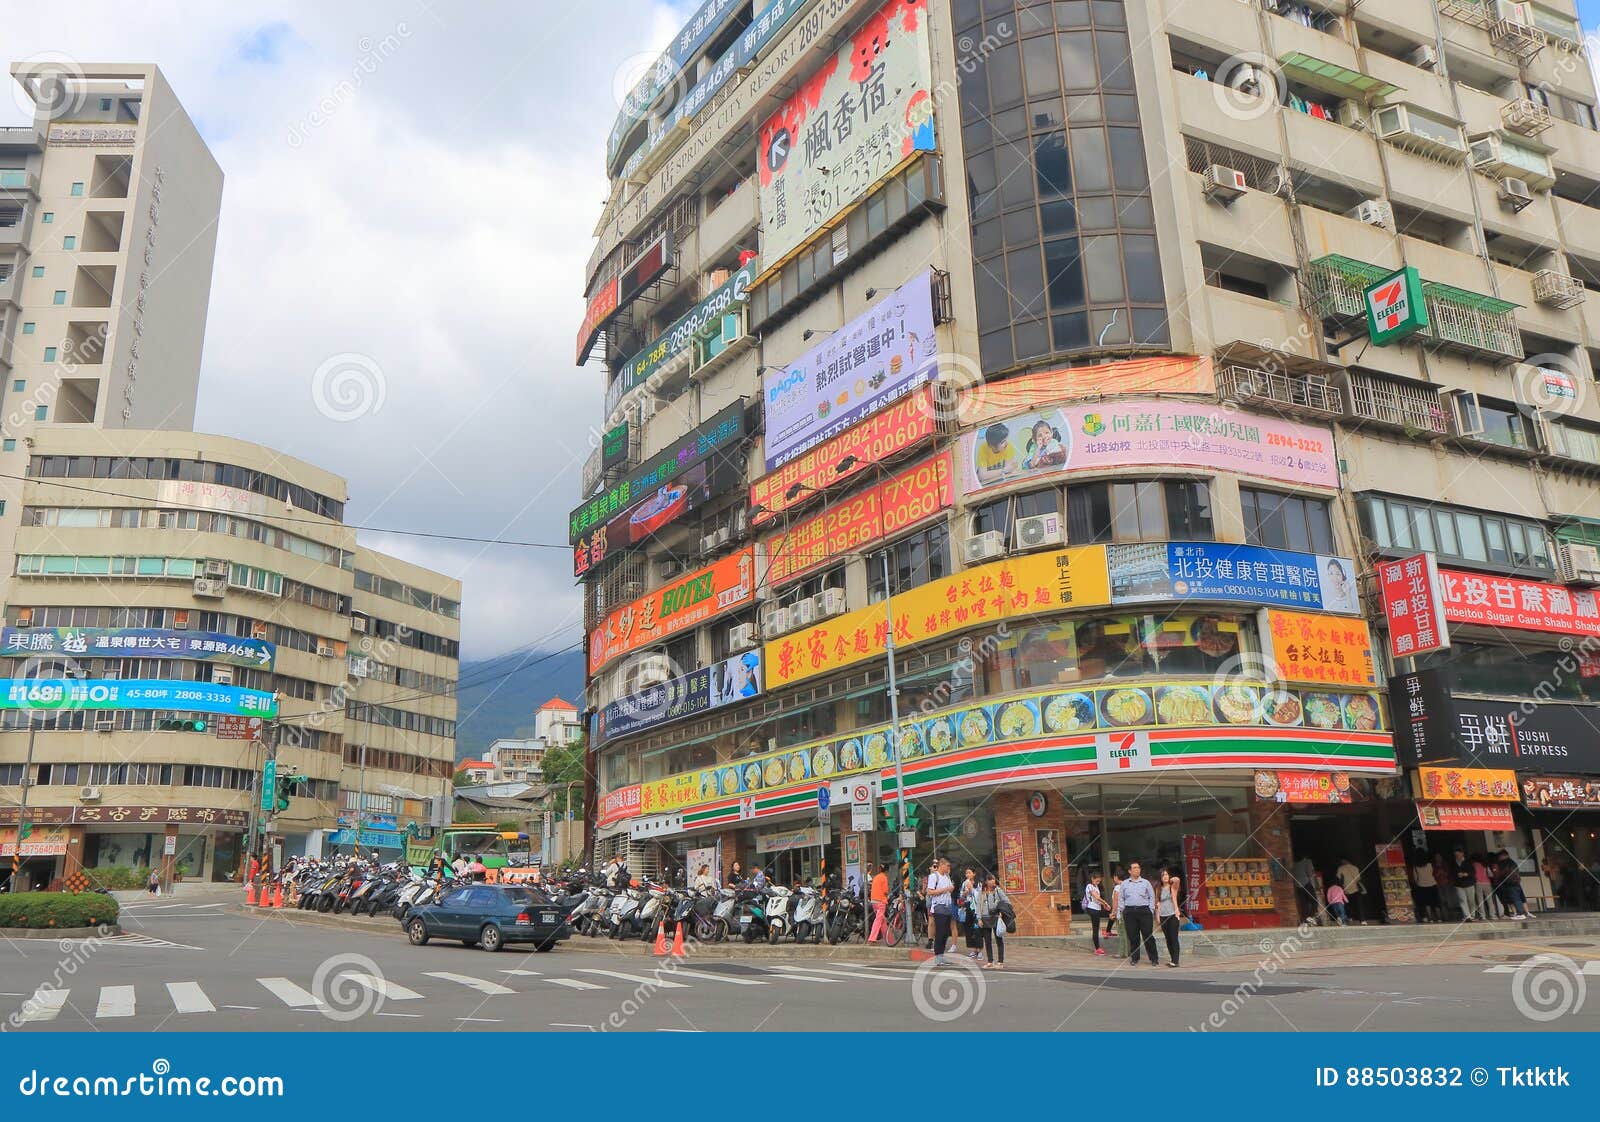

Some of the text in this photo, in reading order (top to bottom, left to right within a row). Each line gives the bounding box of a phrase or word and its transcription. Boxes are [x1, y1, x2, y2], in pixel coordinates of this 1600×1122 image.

[669, 287, 732, 354] 2898-2598
[1111, 413, 1260, 444] 何嘉仁國際幼兒園
[1056, 554, 1073, 604] 請上二樓
[1173, 557, 1319, 590] 北投健康管理醫院
[658, 570, 716, 619] HOTEL
[1223, 584, 1280, 599] 0800-015-104
[1405, 558, 1435, 648] 新北投甘蔗
[1444, 605, 1484, 620] inbeitou
[1486, 610, 1515, 624] Sugar
[1517, 613, 1542, 626] Cane
[1544, 616, 1573, 630] Shabu
[7, 628, 255, 659] 東騰 越 溫泉傳世大宅 泉源路46號
[125, 688, 168, 699] 45-80坪
[174, 689, 232, 703] 2808-3336
[1518, 730, 1551, 743] SUSHI
[1521, 745, 1569, 757] EXPRESS
